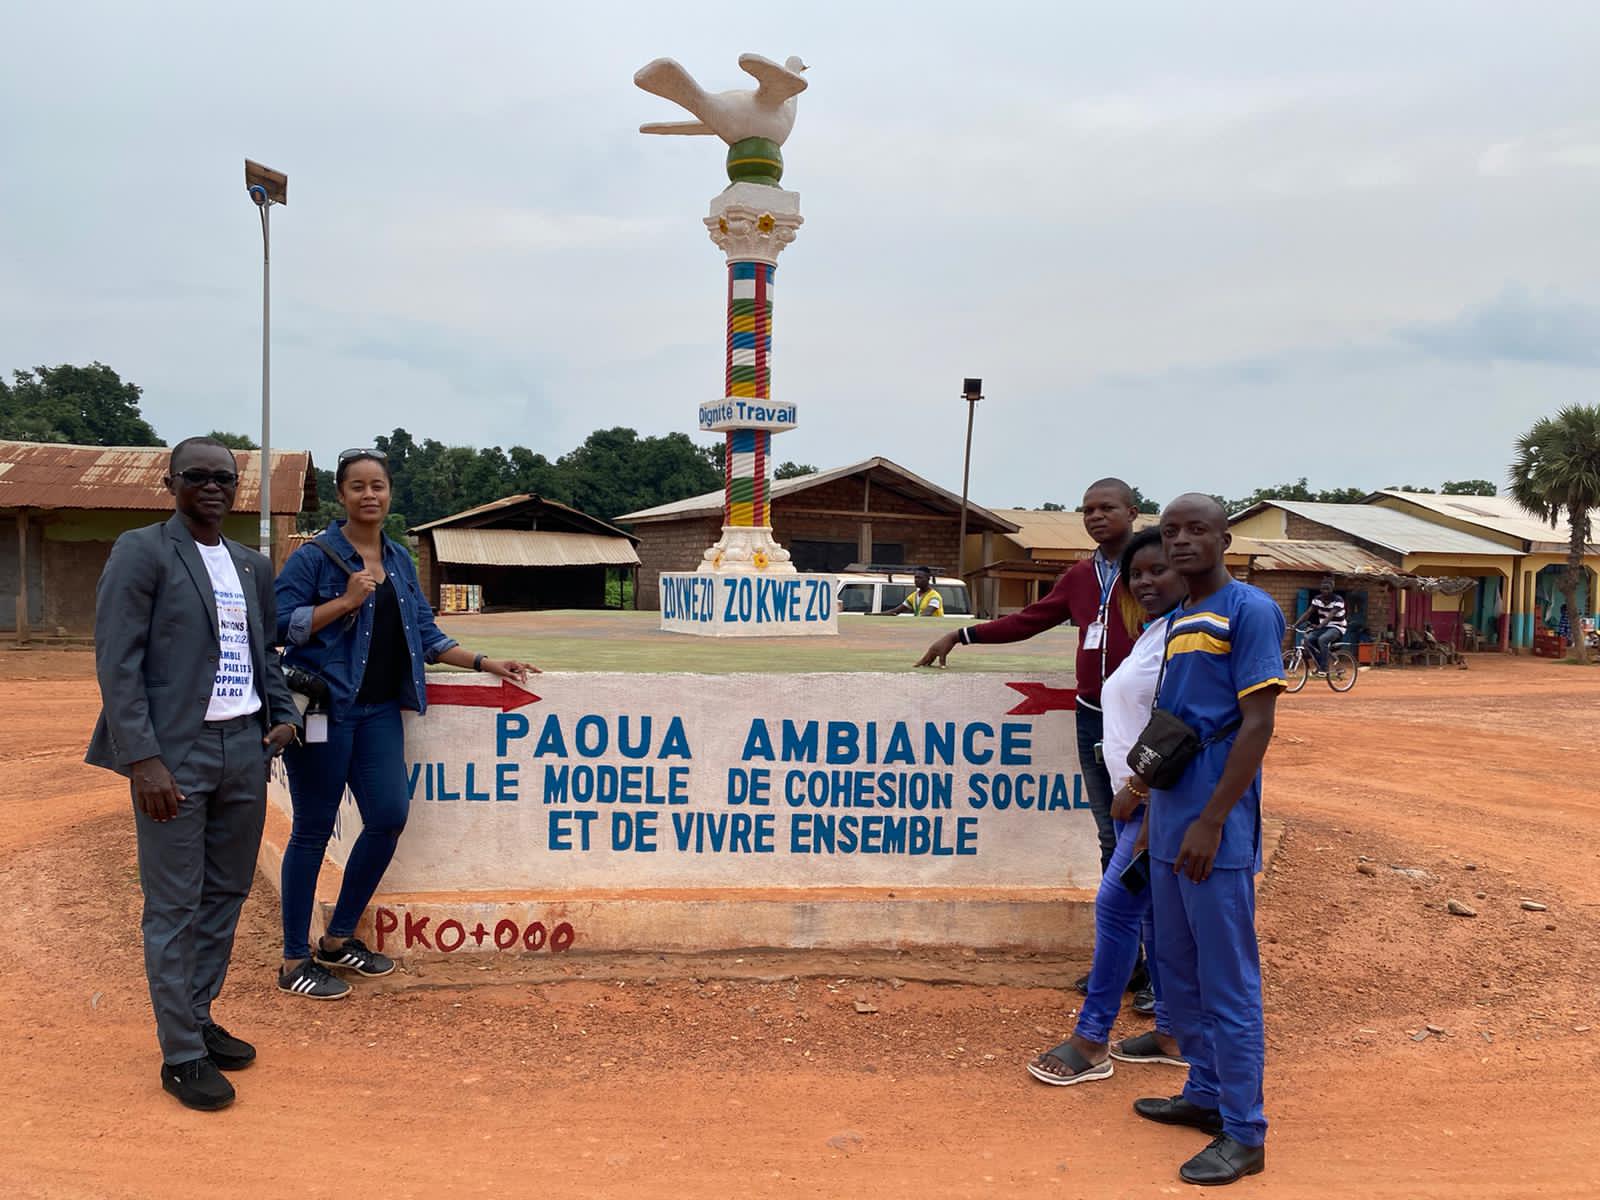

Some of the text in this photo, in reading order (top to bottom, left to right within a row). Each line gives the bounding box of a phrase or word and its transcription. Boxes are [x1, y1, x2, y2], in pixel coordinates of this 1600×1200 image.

[699, 404, 733, 426] Dignité
[736, 402, 796, 423] Travail
[217, 688, 226, 696] LA
[496, 713, 1032, 765] PAOUA AMBIANCE
[544, 765, 689, 804] MODELE
[728, 768, 770, 806] DE
[785, 770, 952, 811] COHESION
[549, 811, 978, 855] ET DE VIVRE ENSEMBLE
